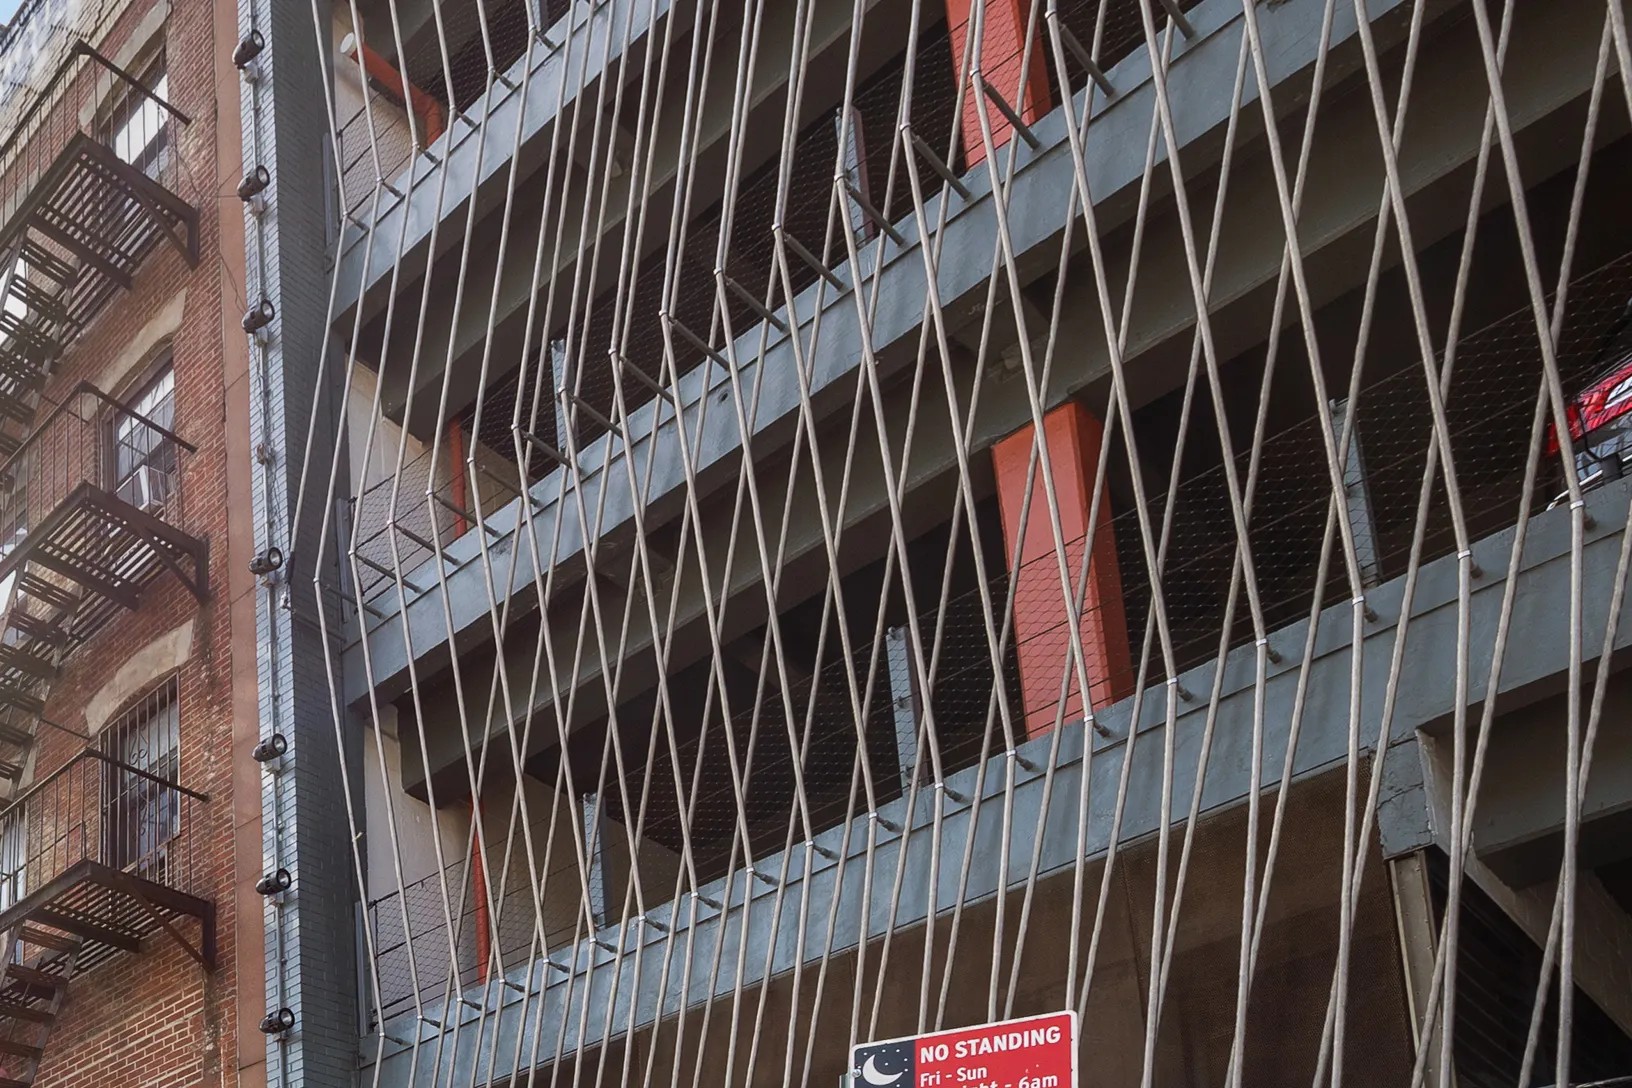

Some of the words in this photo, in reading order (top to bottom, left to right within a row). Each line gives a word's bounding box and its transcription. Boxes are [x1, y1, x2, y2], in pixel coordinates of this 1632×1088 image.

[920, 1044, 949, 1063] NO
[955, 1026, 1061, 1058] STANDING
[920, 1071, 941, 1087] Fri
[956, 1067, 988, 1082] Sun
